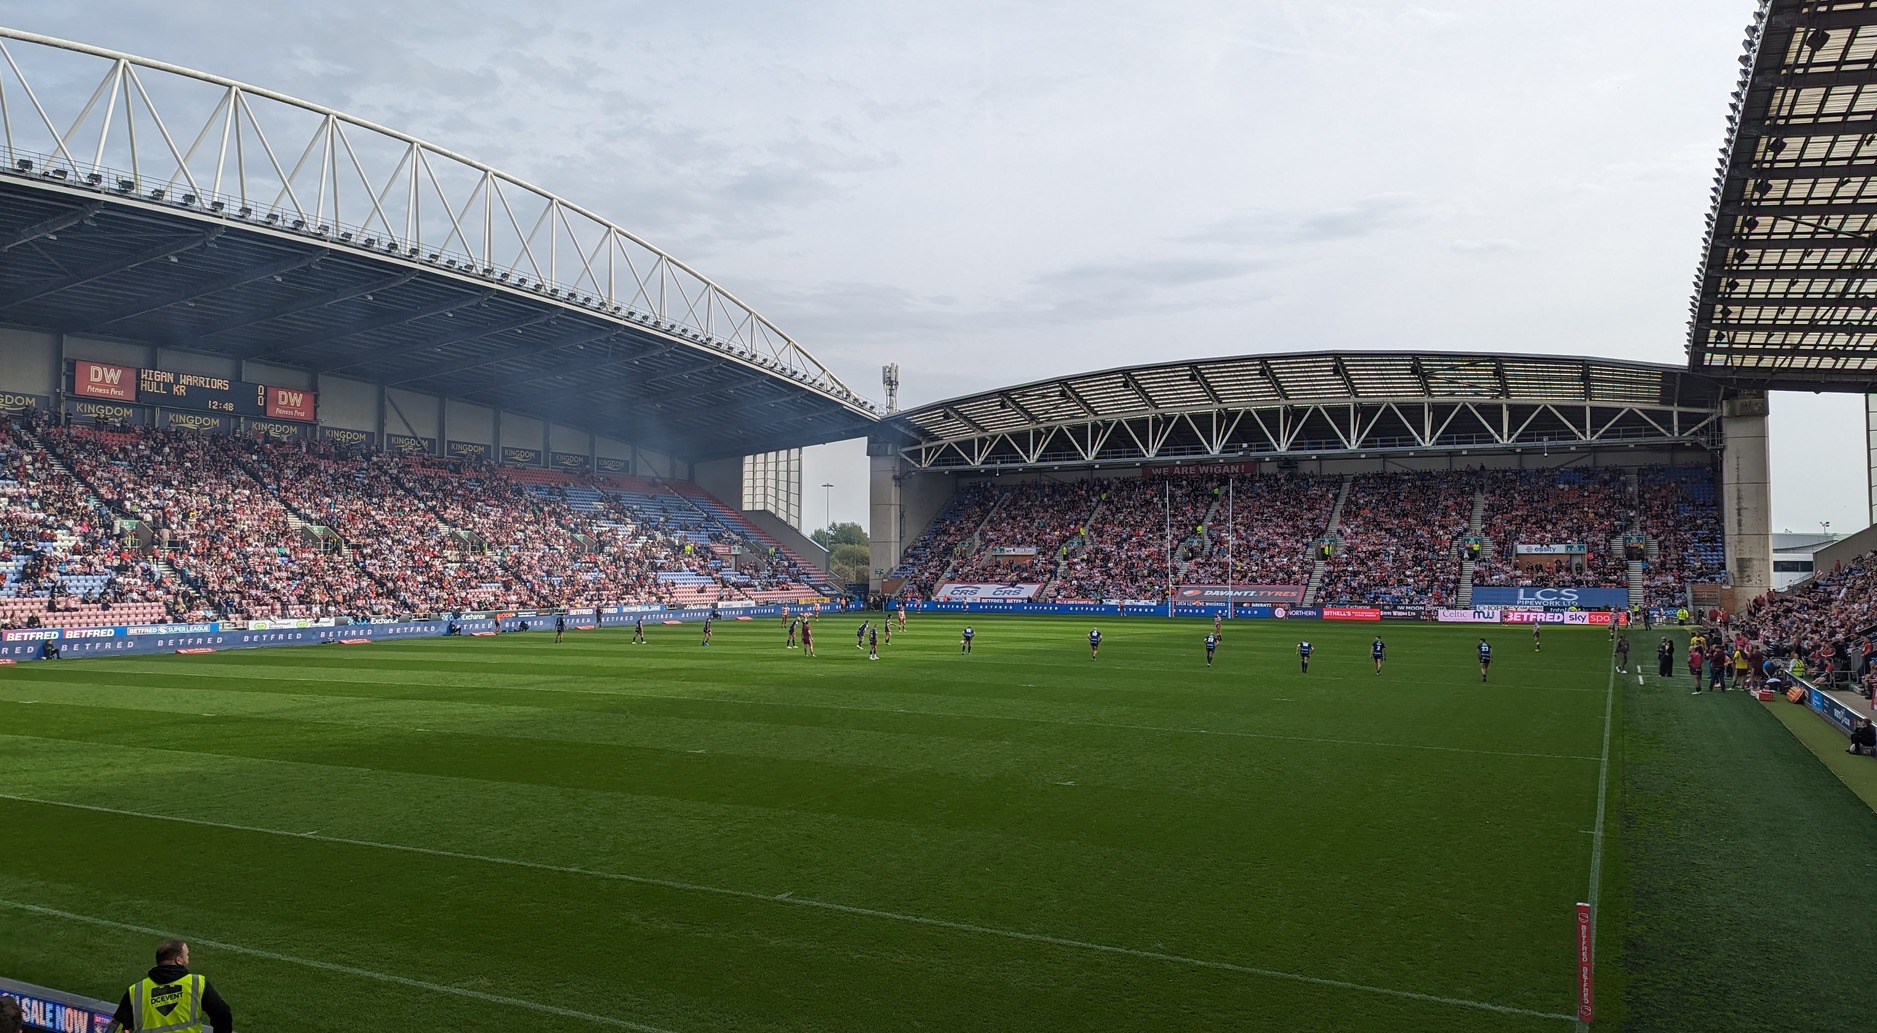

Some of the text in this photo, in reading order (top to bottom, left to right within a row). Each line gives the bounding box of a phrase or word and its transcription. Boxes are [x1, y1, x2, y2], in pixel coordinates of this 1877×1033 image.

[90, 365, 122, 385] DW
[141, 368, 174, 383] WIGAN
[180, 374, 230, 391] WARRIORS
[141, 380, 167, 394] HULL
[173, 384, 186, 396] KR
[278, 390, 303, 407] DW
[76, 402, 133, 418] KINGDOM
[208, 400, 234, 412] 12:48
[169, 413, 220, 428] KINGDOM
[252, 421, 298, 434] KINGDOM
[325, 429, 366, 442] KINGDOM
[451, 443, 485, 454] KINGDOM
[505, 448, 536, 459] KINGDOM
[556, 454, 584, 464] KINGDOM
[600, 459, 625, 468] KINGDOM
[1152, 467, 1170, 476] WE
[1173, 466, 1196, 475] ARE
[1535, 545, 1557, 553] essity
[1518, 588, 1579, 601] LCS
[1443, 610, 1467, 618] Celtic
[1508, 612, 1564, 620] BETFRED
[1569, 613, 1587, 623] sky
[66, 629, 115, 639] BETFRED
[320, 629, 372, 638] BETFRED
[389, 625, 436, 634] BETFRED
[7, 631, 59, 641] BETFRED
[244, 633, 302, 642] BETFRED
[62, 641, 134, 652] BETFRED
[158, 637, 222, 647] BETFRED
[22, 998, 54, 1029] SALE
[56, 1005, 88, 1033] NOW
